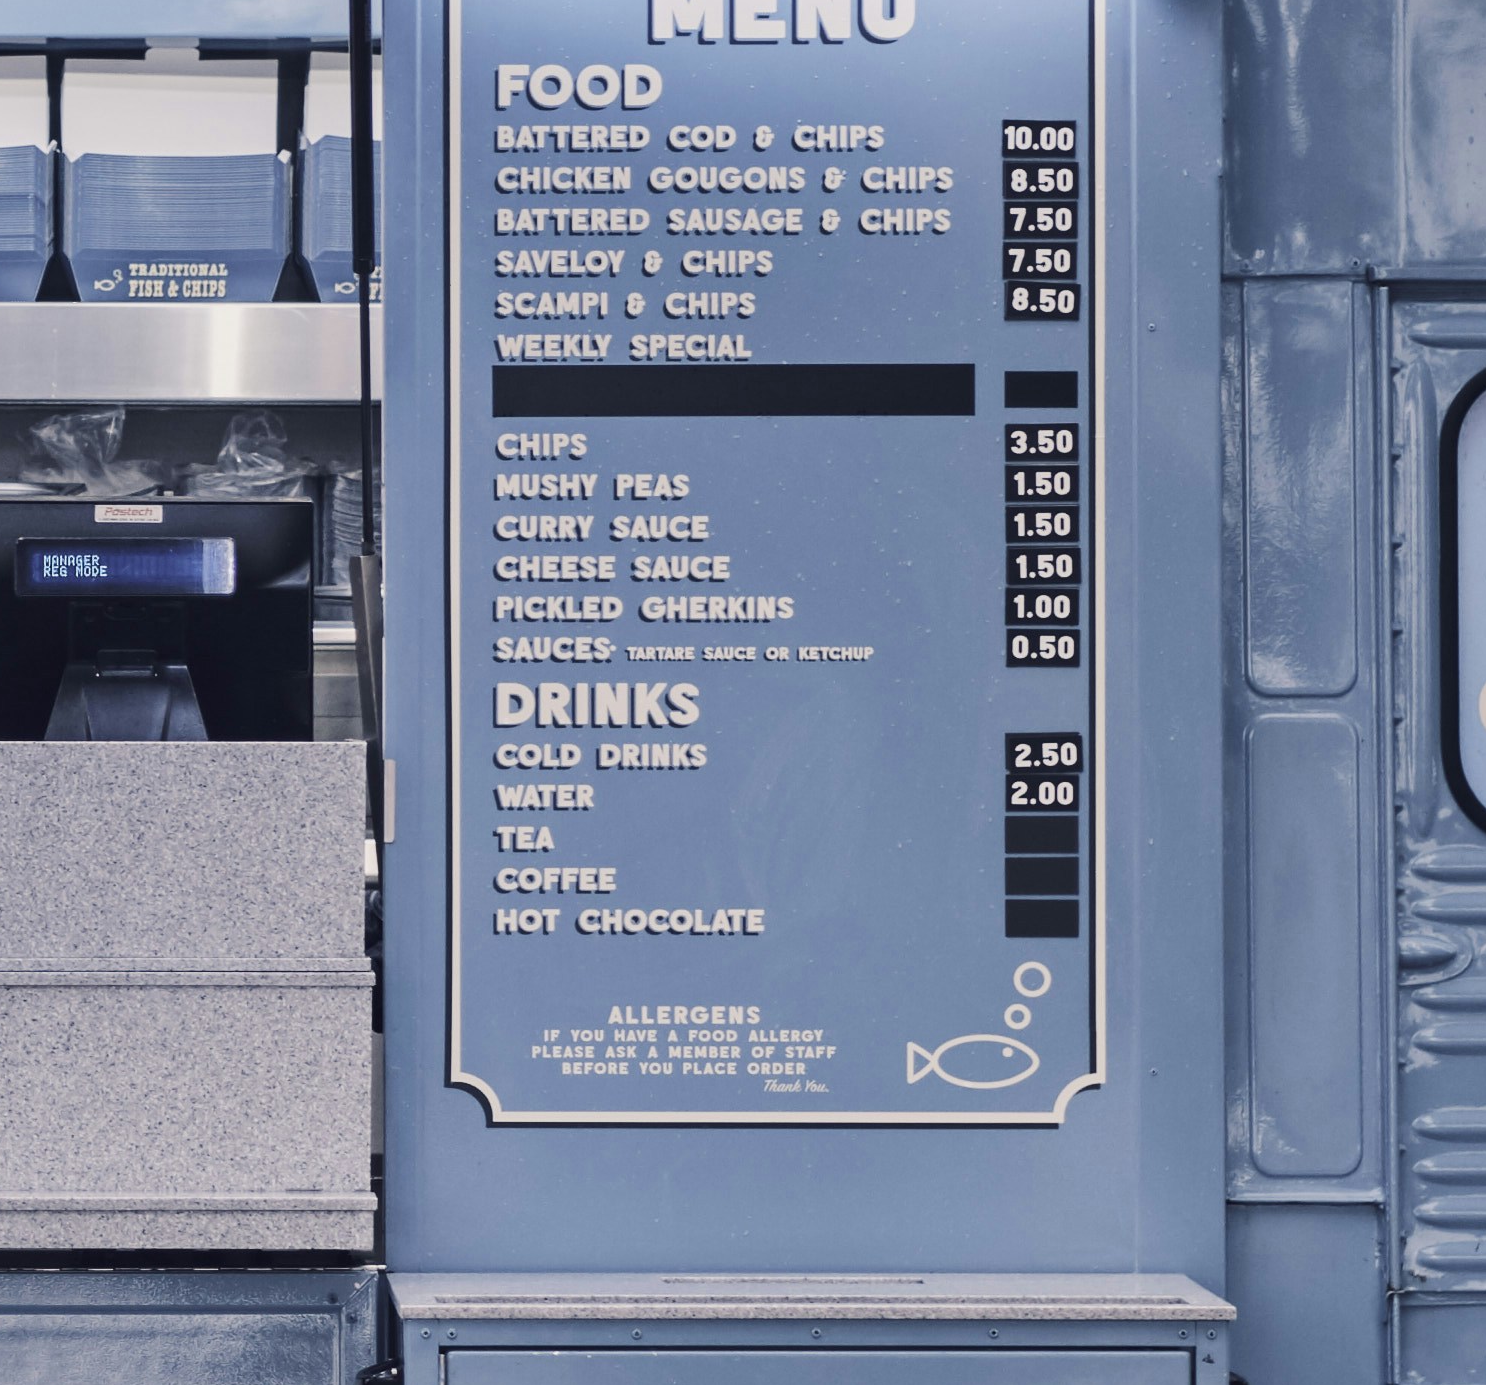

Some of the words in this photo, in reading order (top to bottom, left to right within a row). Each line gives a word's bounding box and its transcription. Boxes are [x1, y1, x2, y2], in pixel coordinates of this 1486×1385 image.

[498, 63, 664, 107] FOOD
[129, 264, 228, 276] TRADITIONAL
[497, 249, 626, 273] SAVELOY
[644, 249, 664, 273] &
[683, 249, 773, 274] CHIPS
[1008, 248, 1071, 273] 7.50
[129, 279, 164, 297] FISH
[168, 280, 179, 297] &
[183, 279, 226, 297] CHIPS
[1011, 287, 1075, 314] 8.50
[497, 291, 609, 316] SCAMPI
[627, 291, 646, 316] &
[665, 291, 756, 316] CHIPS
[497, 333, 613, 358] WEEKLY
[631, 334, 753, 358] SPECIAL
[497, 432, 588, 457] CHIPS
[1010, 429, 1074, 455] 3.50
[496, 473, 599, 497] MUSHY
[616, 473, 690, 497] PEAS
[1013, 471, 1071, 496] 1.50
[496, 514, 595, 539] CURRY
[613, 515, 710, 539] SAUCE
[1013, 512, 1071, 537] 1.50
[43, 554, 100, 566] MANAGER
[43, 565, 68, 577] REG
[75, 565, 108, 577] MODE
[496, 555, 617, 579] CHEESE
[634, 555, 731, 579] SAUCE
[1015, 553, 1073, 579] 1.50
[496, 595, 624, 620] PICKLED
[642, 595, 795, 620] GHERKINS
[1013, 594, 1071, 619] 1.00
[626, 646, 696, 660] TARTARE
[703, 646, 757, 660] SAUCE
[765, 646, 790, 660] OR
[798, 646, 875, 660] KETCHUP
[1011, 635, 1075, 660] 0.50
[496, 682, 701, 726] DRINKS
[497, 743, 583, 767] COLD
[600, 743, 708, 767] DRINKS
[1014, 742, 1077, 768] 2.50
[497, 783, 595, 808] WATER
[1011, 780, 1074, 806] 2.00
[496, 825, 555, 850] TEA
[497, 867, 617, 891] COFFEE
[496, 907, 561, 932] HOT
[579, 908, 766, 933] CHOCOLATE
[607, 1005, 761, 1026] ALLERGENS
[543, 1029, 561, 1042] IF
[570, 1029, 605, 1043] YOU
[614, 1029, 658, 1043] HAVE
[667, 1029, 679, 1042] A
[688, 1029, 738, 1043] FOOD
[748, 1029, 824, 1043] ALLERGY
[531, 1045, 595, 1059] PLEASE
[605, 1045, 637, 1059] ASK
[647, 1045, 659, 1059] A
[668, 1045, 741, 1059] MEMBER
[751, 1045, 776, 1059] OF
[785, 1045, 837, 1060] STAFF
[561, 1061, 629, 1076] BEFORE
[638, 1061, 673, 1076] YOU
[682, 1061, 737, 1076] PLACE
[746, 1061, 806, 1076] ORDER
[763, 1078, 802, 1093] Thank
